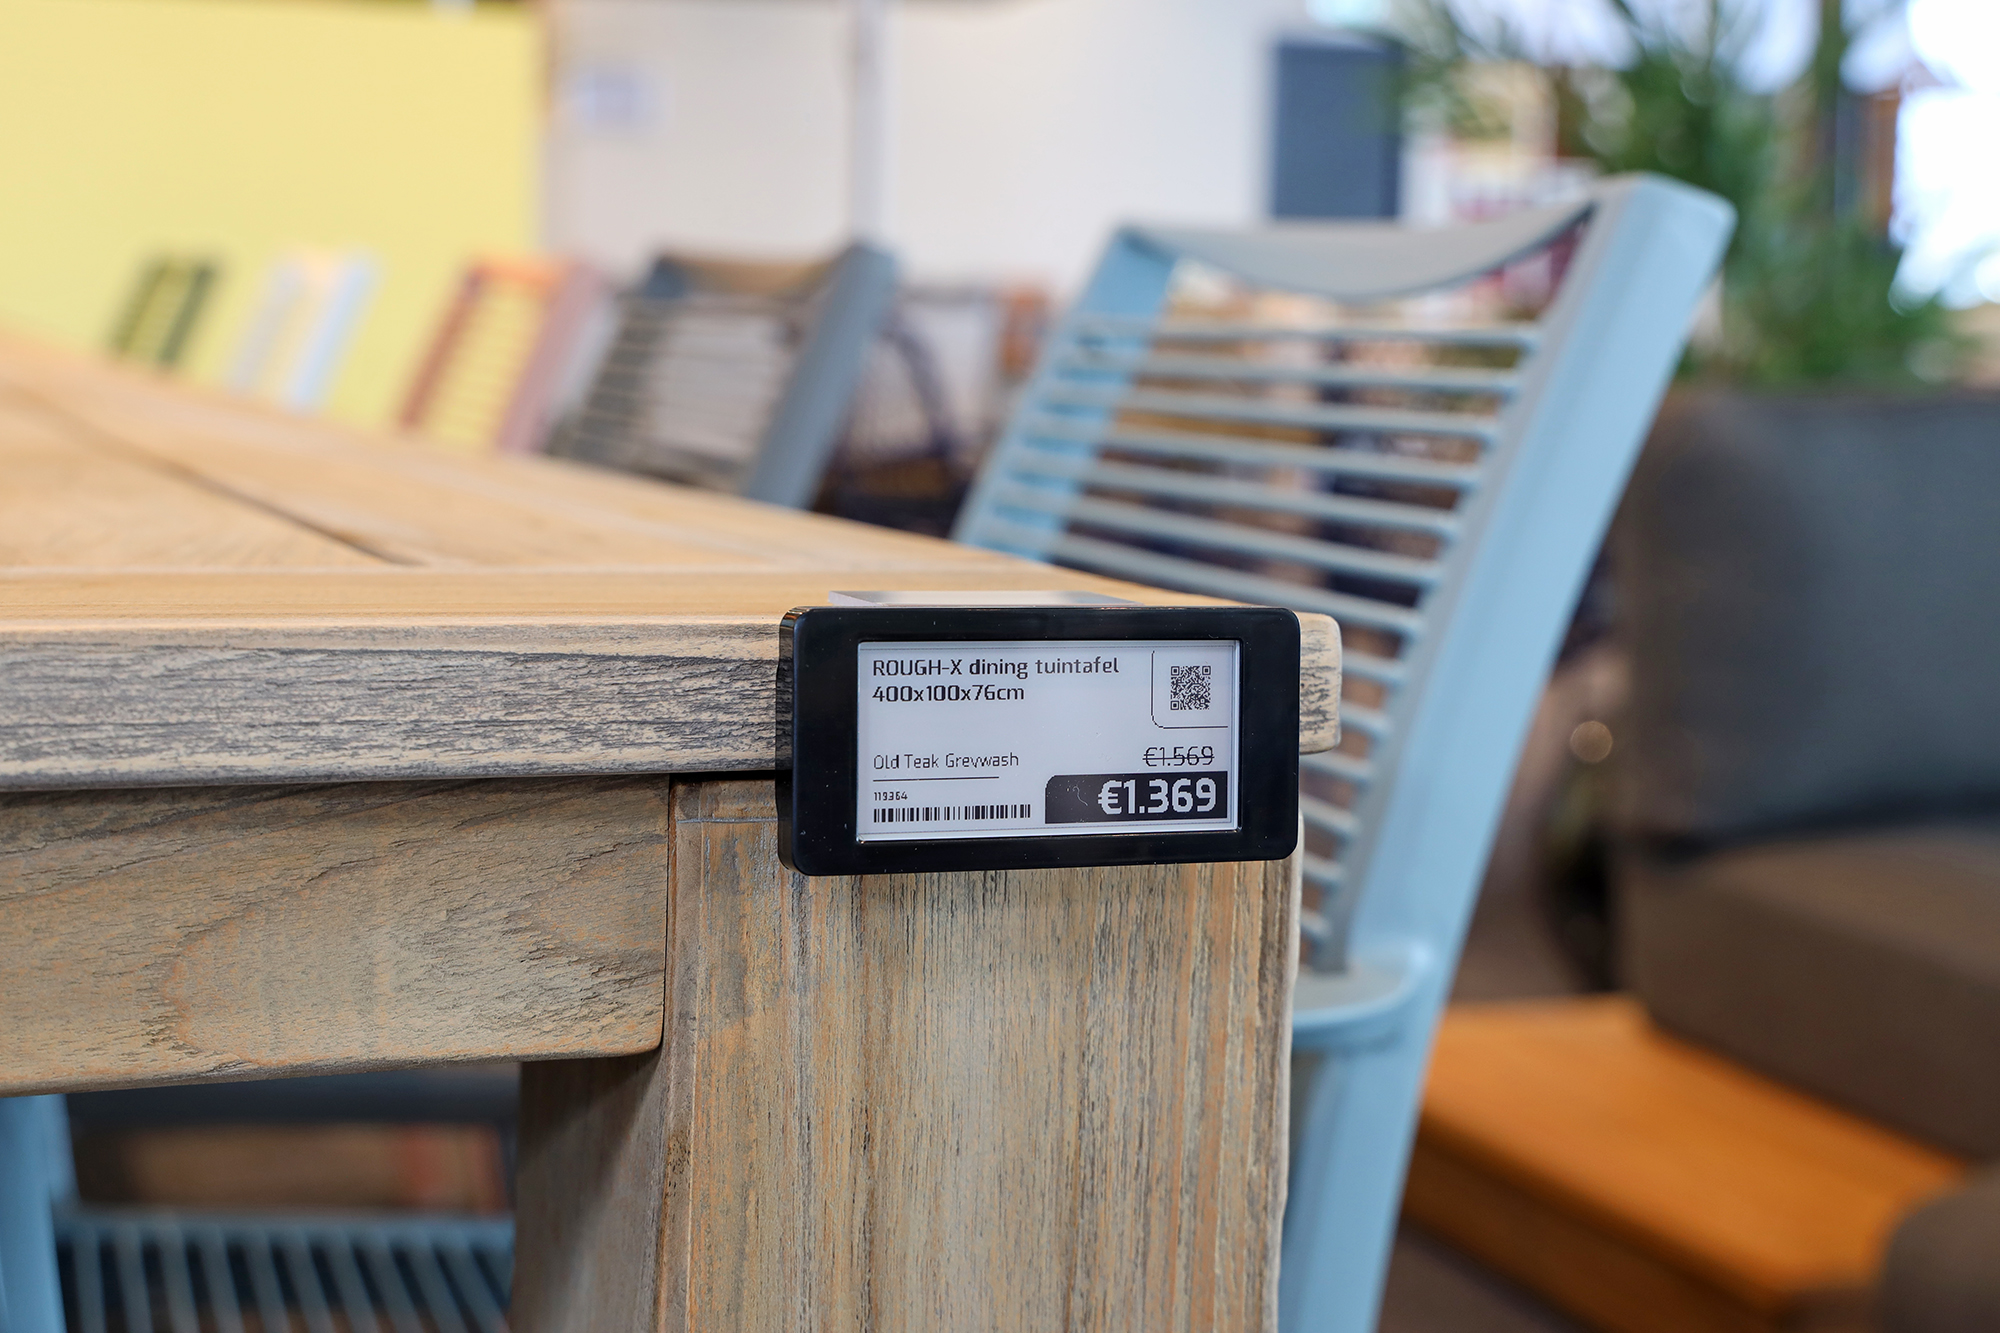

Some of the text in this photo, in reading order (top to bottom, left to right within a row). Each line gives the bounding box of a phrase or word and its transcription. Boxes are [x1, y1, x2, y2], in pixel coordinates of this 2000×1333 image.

[872, 656, 1120, 680] ROUGH-X dining tuintafel
[872, 684, 1025, 702] 400x100x76cm
[873, 754, 900, 770] Old
[903, 753, 940, 769] Teak
[1142, 745, 1215, 767] €1.569
[873, 790, 909, 801] 119364
[1097, 777, 1217, 815] €1.369
